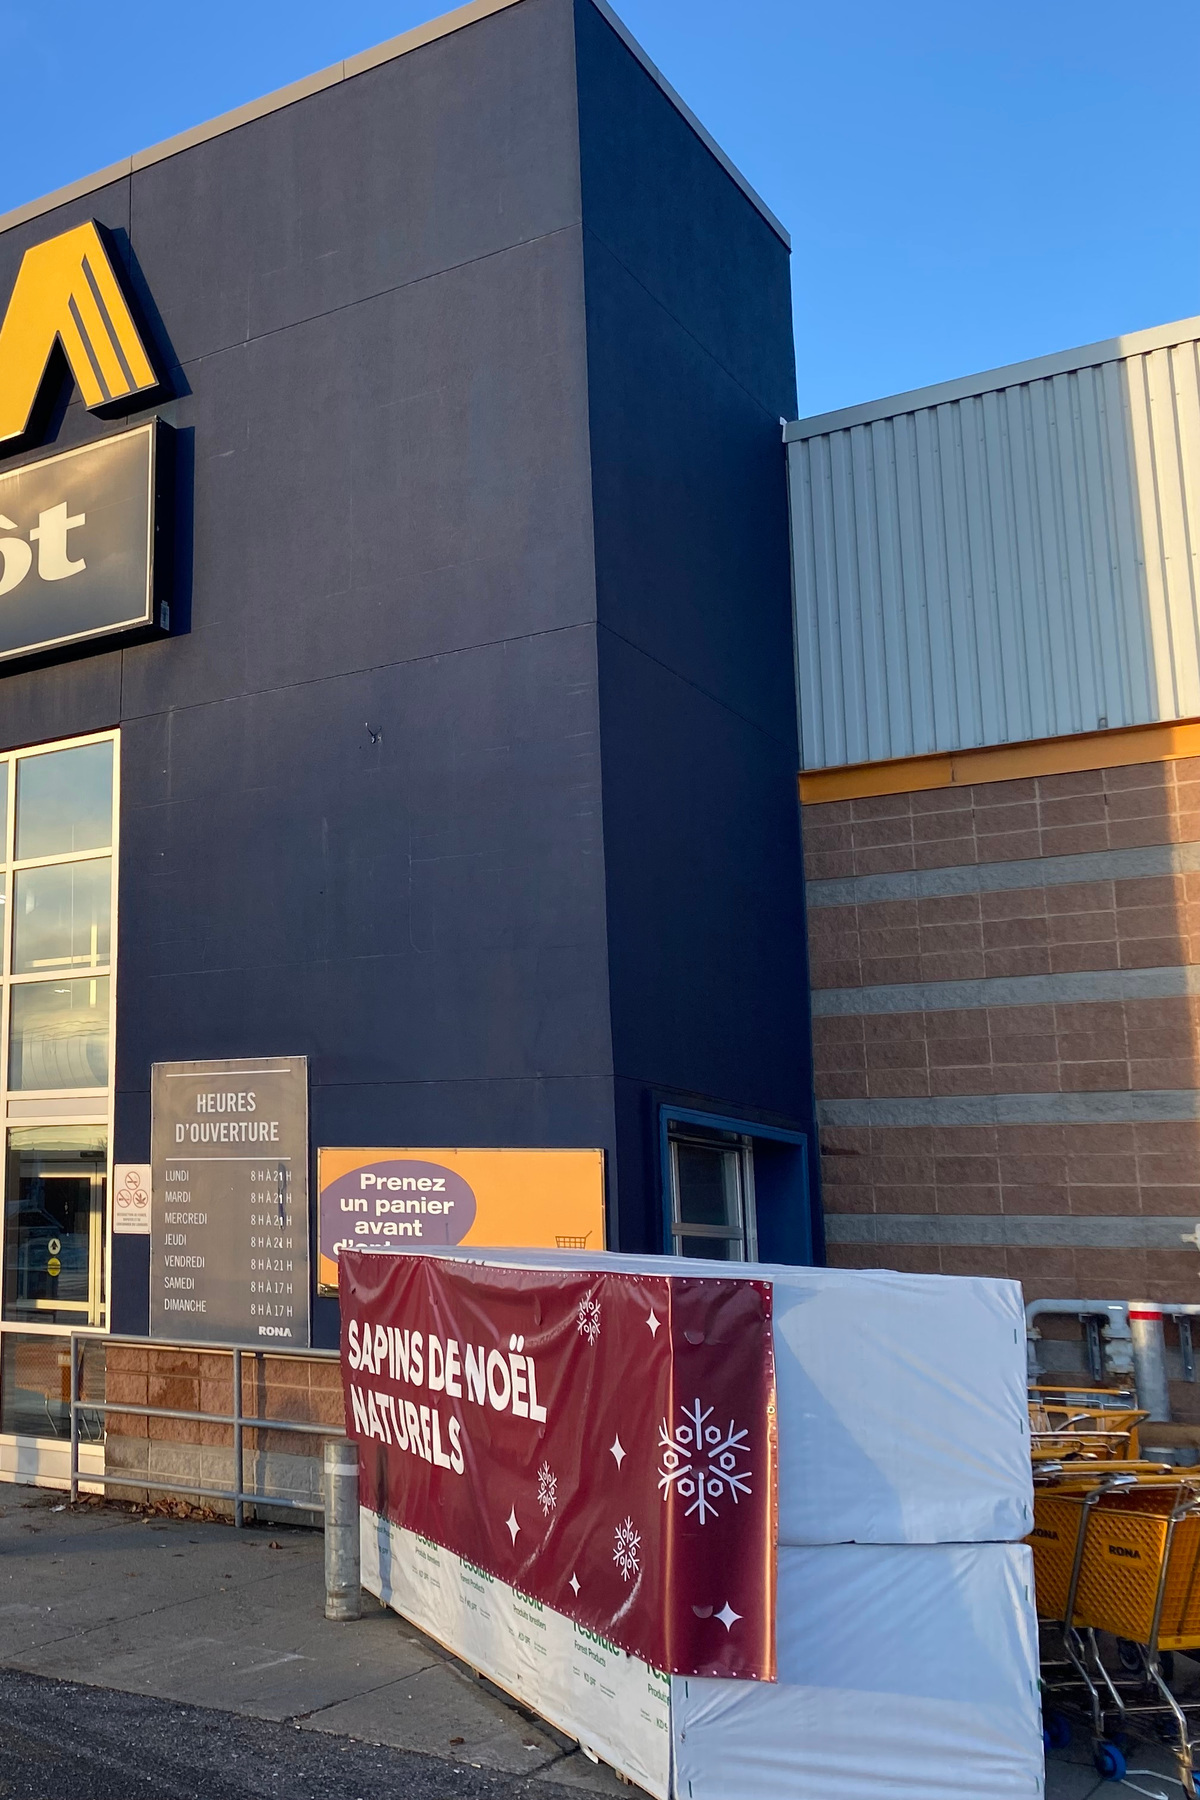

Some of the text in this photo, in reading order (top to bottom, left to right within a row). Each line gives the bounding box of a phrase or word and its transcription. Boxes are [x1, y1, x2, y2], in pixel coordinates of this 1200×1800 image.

[196, 1092, 257, 1113] HEURES
[175, 1121, 280, 1142] D'OUVERTURE
[165, 1170, 190, 1181] LUNDI
[250, 1170, 256, 1181] 8
[258, 1170, 264, 1181] H
[273, 1170, 283, 1181] 21
[286, 1170, 292, 1181] H
[360, 1173, 446, 1192] Prenez
[164, 1191, 191, 1203] MARDI
[250, 1192, 256, 1203] 8
[258, 1192, 264, 1203] H
[273, 1192, 283, 1204] 21
[286, 1192, 292, 1204] H
[340, 1196, 455, 1217] un panier
[164, 1212, 208, 1224] MERCREDI
[250, 1214, 256, 1225] 8
[258, 1214, 264, 1225] H
[273, 1214, 283, 1226] 21
[286, 1214, 292, 1226] H
[354, 1219, 423, 1237] avant
[164, 1233, 187, 1246] JEUDI
[250, 1236, 256, 1248] 8
[258, 1236, 264, 1248] H
[273, 1237, 283, 1248] 21
[286, 1237, 292, 1248] H
[164, 1255, 205, 1268] VENDREDI
[250, 1258, 256, 1270] 8
[258, 1258, 264, 1270] H
[273, 1259, 283, 1271] 21
[286, 1259, 292, 1271] H
[164, 1276, 195, 1290] SAMEDI
[250, 1281, 256, 1293] 8
[258, 1281, 264, 1293] H
[273, 1282, 284, 1294] 17
[286, 1282, 292, 1294] H
[164, 1298, 207, 1312] DIMANCHE
[250, 1303, 256, 1315] 8
[258, 1303, 264, 1315] H
[273, 1304, 284, 1317] 17
[286, 1304, 292, 1317] H
[258, 1325, 293, 1337] RONA
[348, 1319, 548, 1424] SAPINS DE NOËL
[350, 1383, 465, 1475] NATURELS
[1108, 1544, 1141, 1559] RONA
